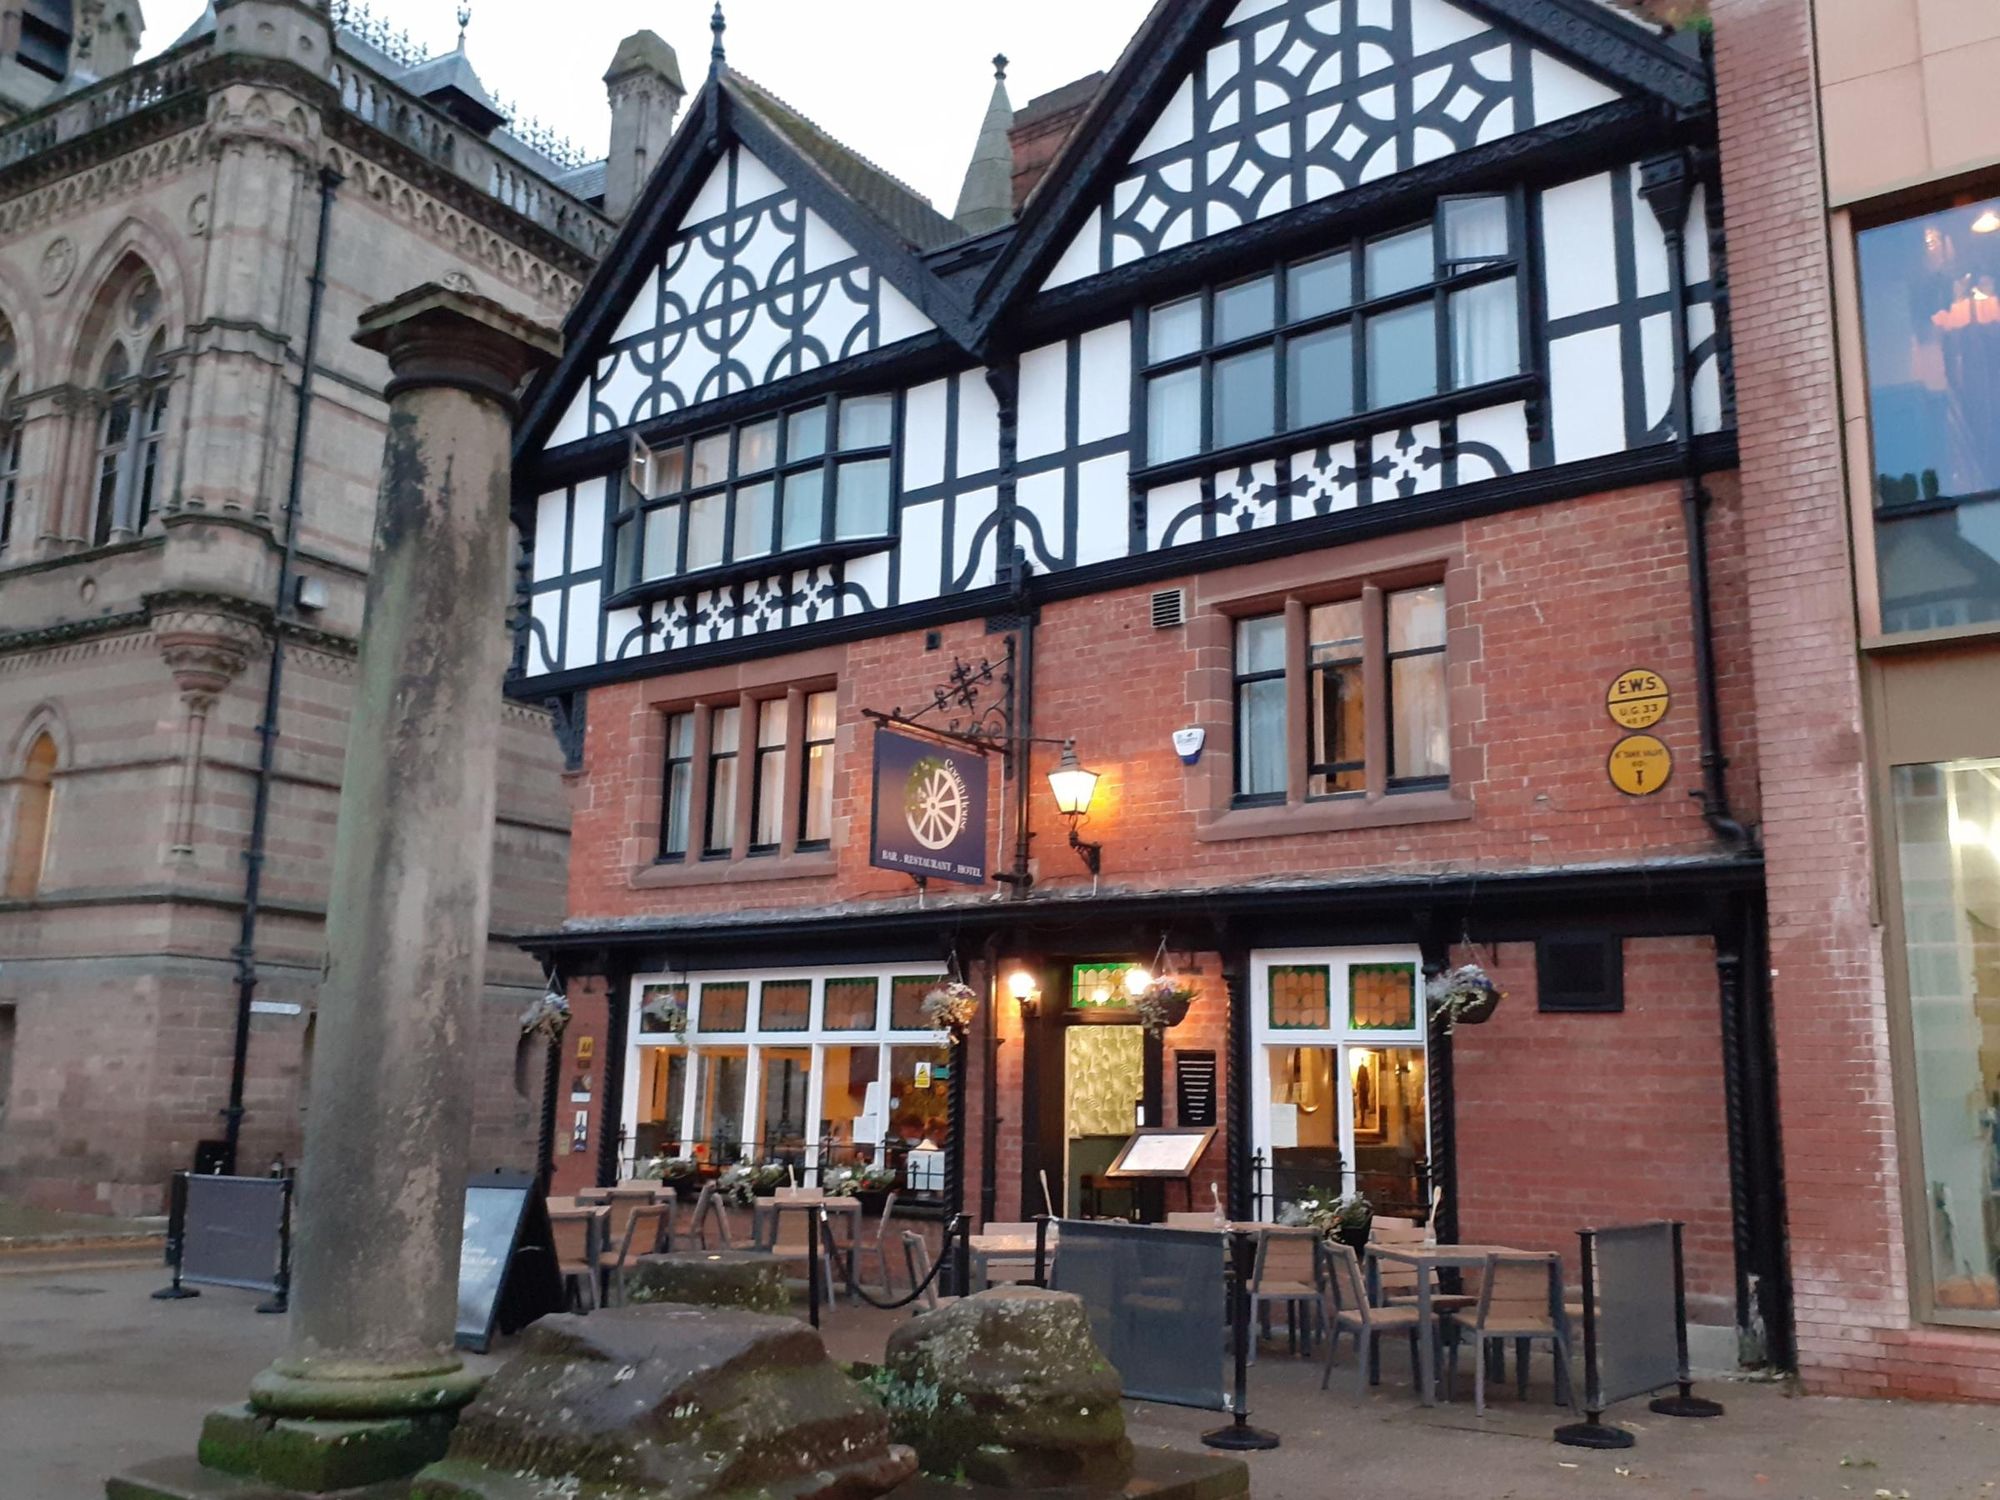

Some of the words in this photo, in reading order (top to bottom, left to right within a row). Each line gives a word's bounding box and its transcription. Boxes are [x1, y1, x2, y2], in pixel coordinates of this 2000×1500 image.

[882, 850, 898, 862] BAR
[903, 854, 952, 871] RESTAURANT
[957, 865, 982, 877] HOTEL
